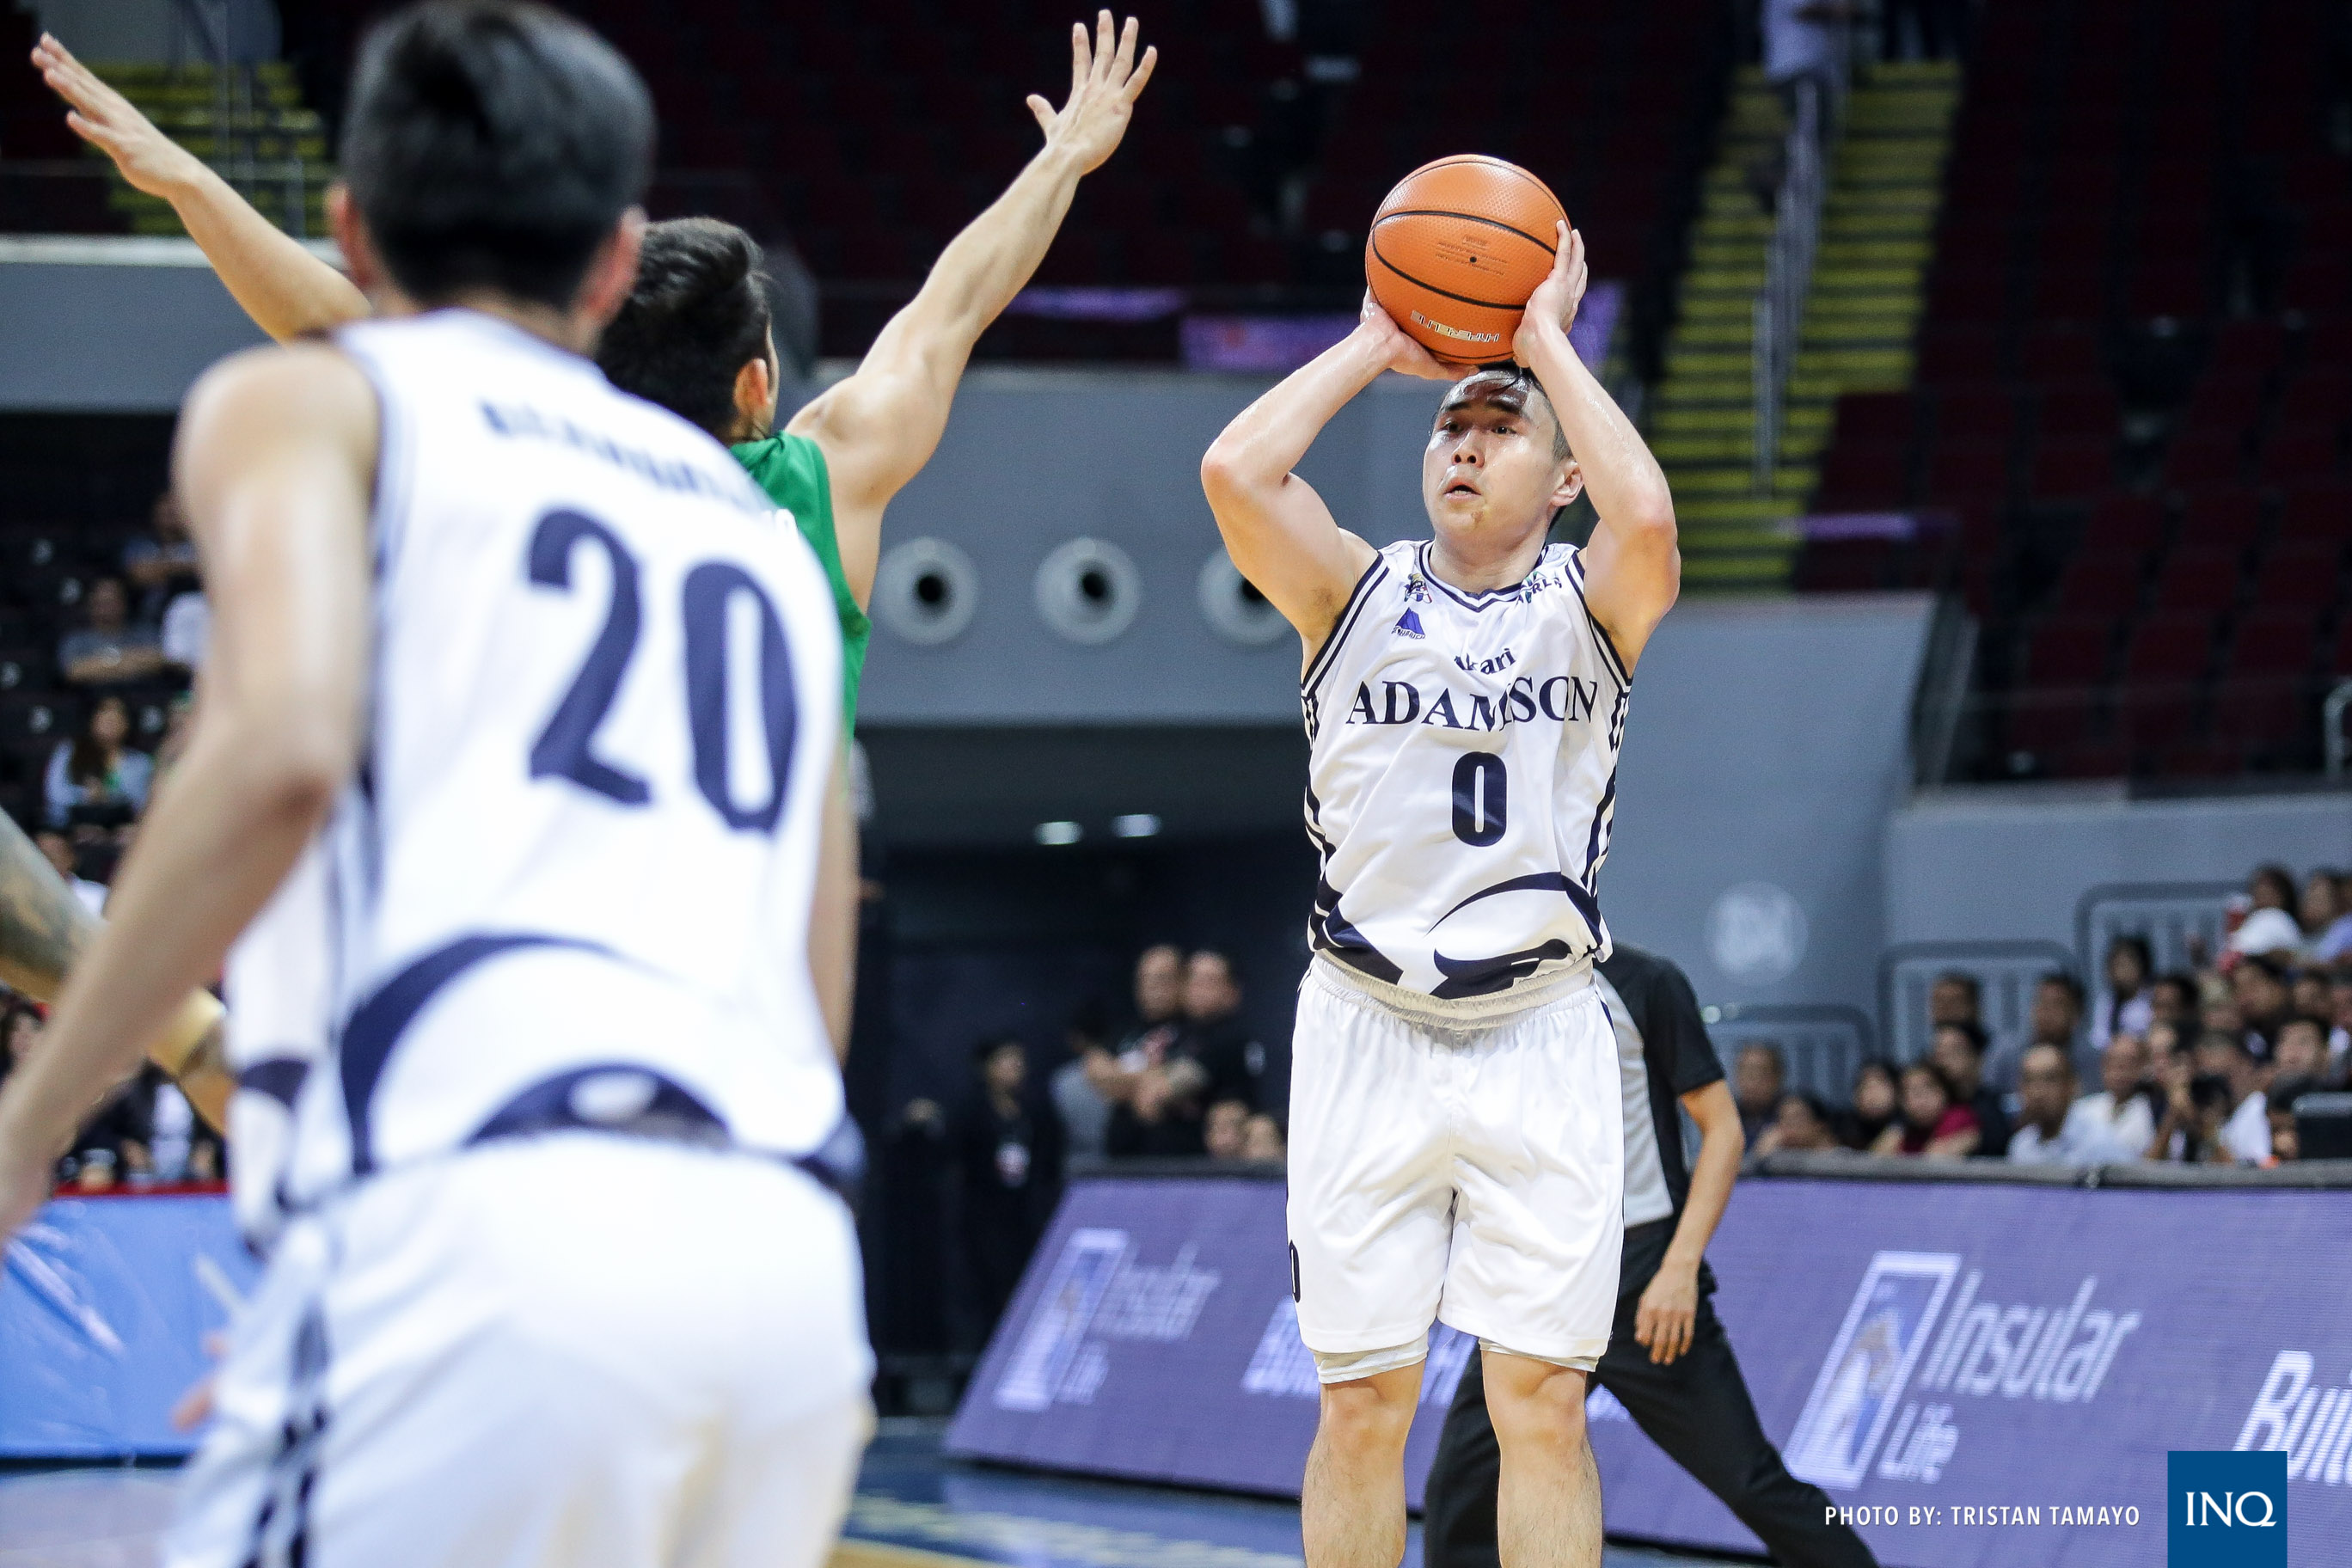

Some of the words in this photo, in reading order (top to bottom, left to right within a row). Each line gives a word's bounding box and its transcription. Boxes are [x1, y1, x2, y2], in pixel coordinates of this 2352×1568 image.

[526, 505, 799, 835] 20
[1346, 676, 1598, 732] ADAMSON
[1451, 750, 1508, 848] 0
[1920, 1268, 2143, 1403] Insular
